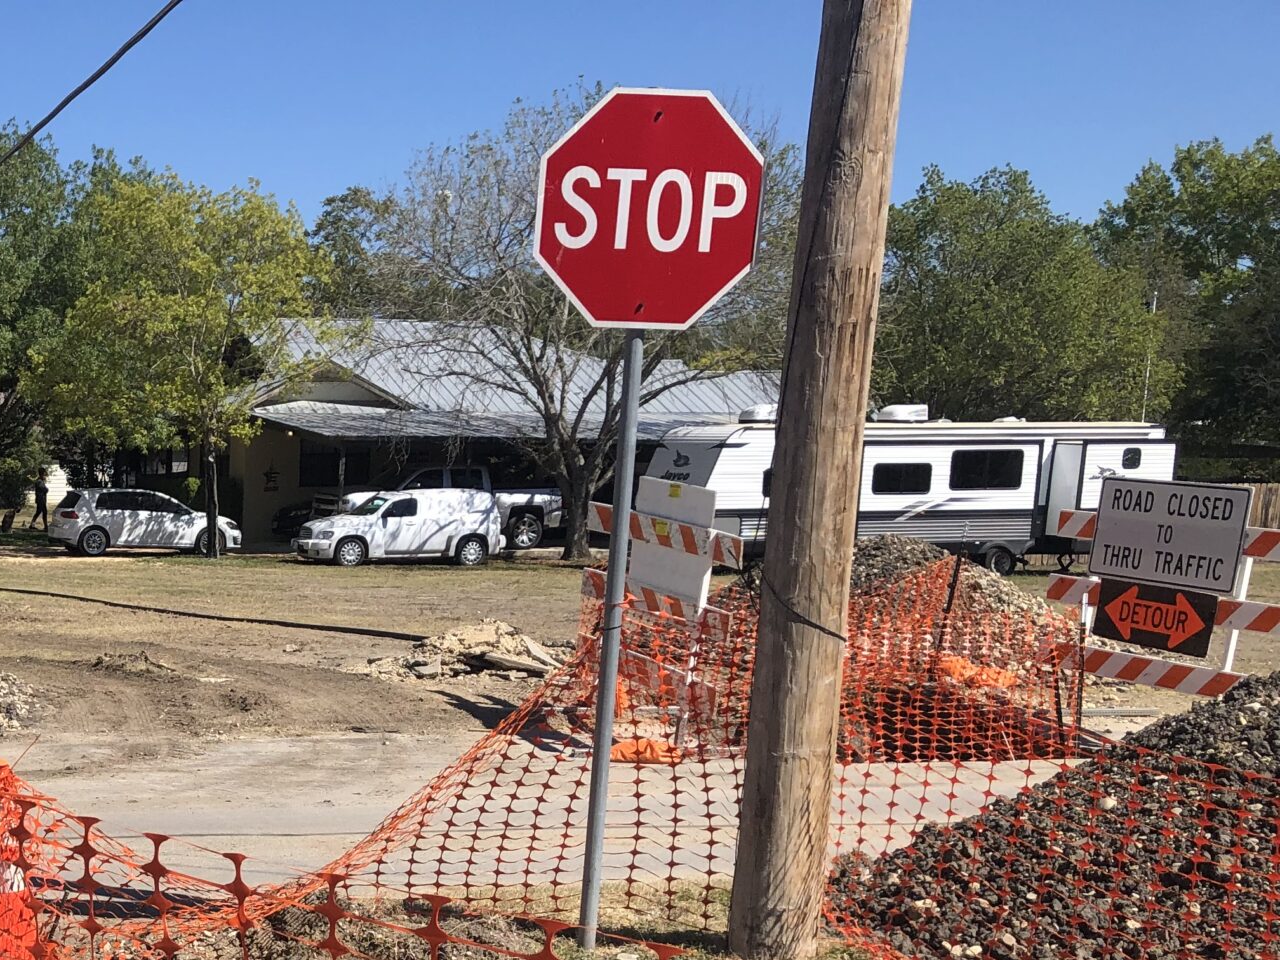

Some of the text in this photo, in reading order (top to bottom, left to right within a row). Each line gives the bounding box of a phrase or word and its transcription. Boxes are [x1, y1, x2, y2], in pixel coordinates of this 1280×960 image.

[554, 165, 748, 253] STOP
[1111, 488, 1234, 521] ROAD CLOSED
[1156, 524, 1173, 544] TO
[1102, 544, 1224, 581] THRU TRAFFIC
[1118, 600, 1189, 633] DETOUR
